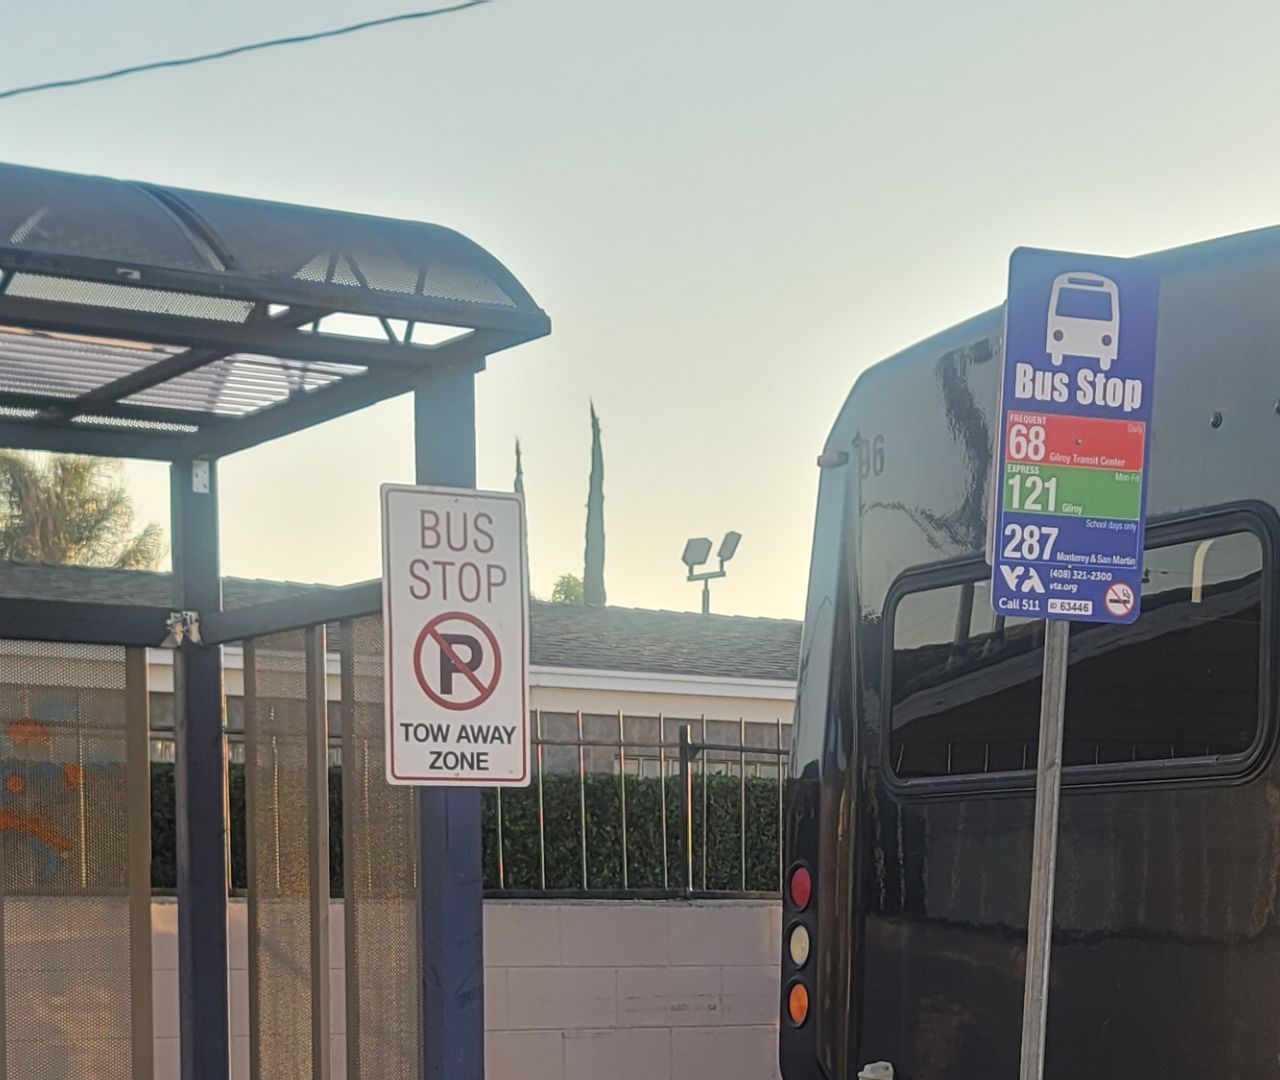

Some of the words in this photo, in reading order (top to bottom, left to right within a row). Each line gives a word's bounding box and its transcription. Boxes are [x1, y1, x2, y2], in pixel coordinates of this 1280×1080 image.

[1015, 363, 1069, 403] Bus
[1076, 368, 1142, 412] Stop
[1009, 414, 1047, 425] FREQUENT
[1009, 424, 1046, 461] 68
[1049, 452, 1071, 464] Gilroy
[1073, 454, 1099, 465] Transit
[1100, 456, 1126, 467] Center
[1007, 464, 1040, 475] EXPRESS
[1115, 472, 1141, 483] Mon-Fri
[1007, 474, 1057, 512] 121
[1062, 503, 1083, 515] Gilroy
[420, 509, 494, 553] BUS
[1085, 519, 1107, 529] School
[1107, 520, 1123, 531] days
[1123, 522, 1137, 533] only
[1004, 523, 1059, 560] 287
[1056, 551, 1089, 564] Monterey
[1090, 554, 1096, 563] &
[1096, 554, 1111, 564] San
[1112, 555, 1137, 565] Martin
[409, 559, 507, 604] STOP
[1049, 568, 1071, 579] (408)
[1072, 570, 1113, 581] 321-2300
[1049, 582, 1078, 594] vta.org
[999, 597, 1020, 610] Call
[1021, 599, 1041, 611] 511
[1060, 601, 1089, 612] 63446
[399, 722, 451, 743] TOW
[456, 724, 517, 745] AWAY
[428, 750, 490, 771] ZONE
